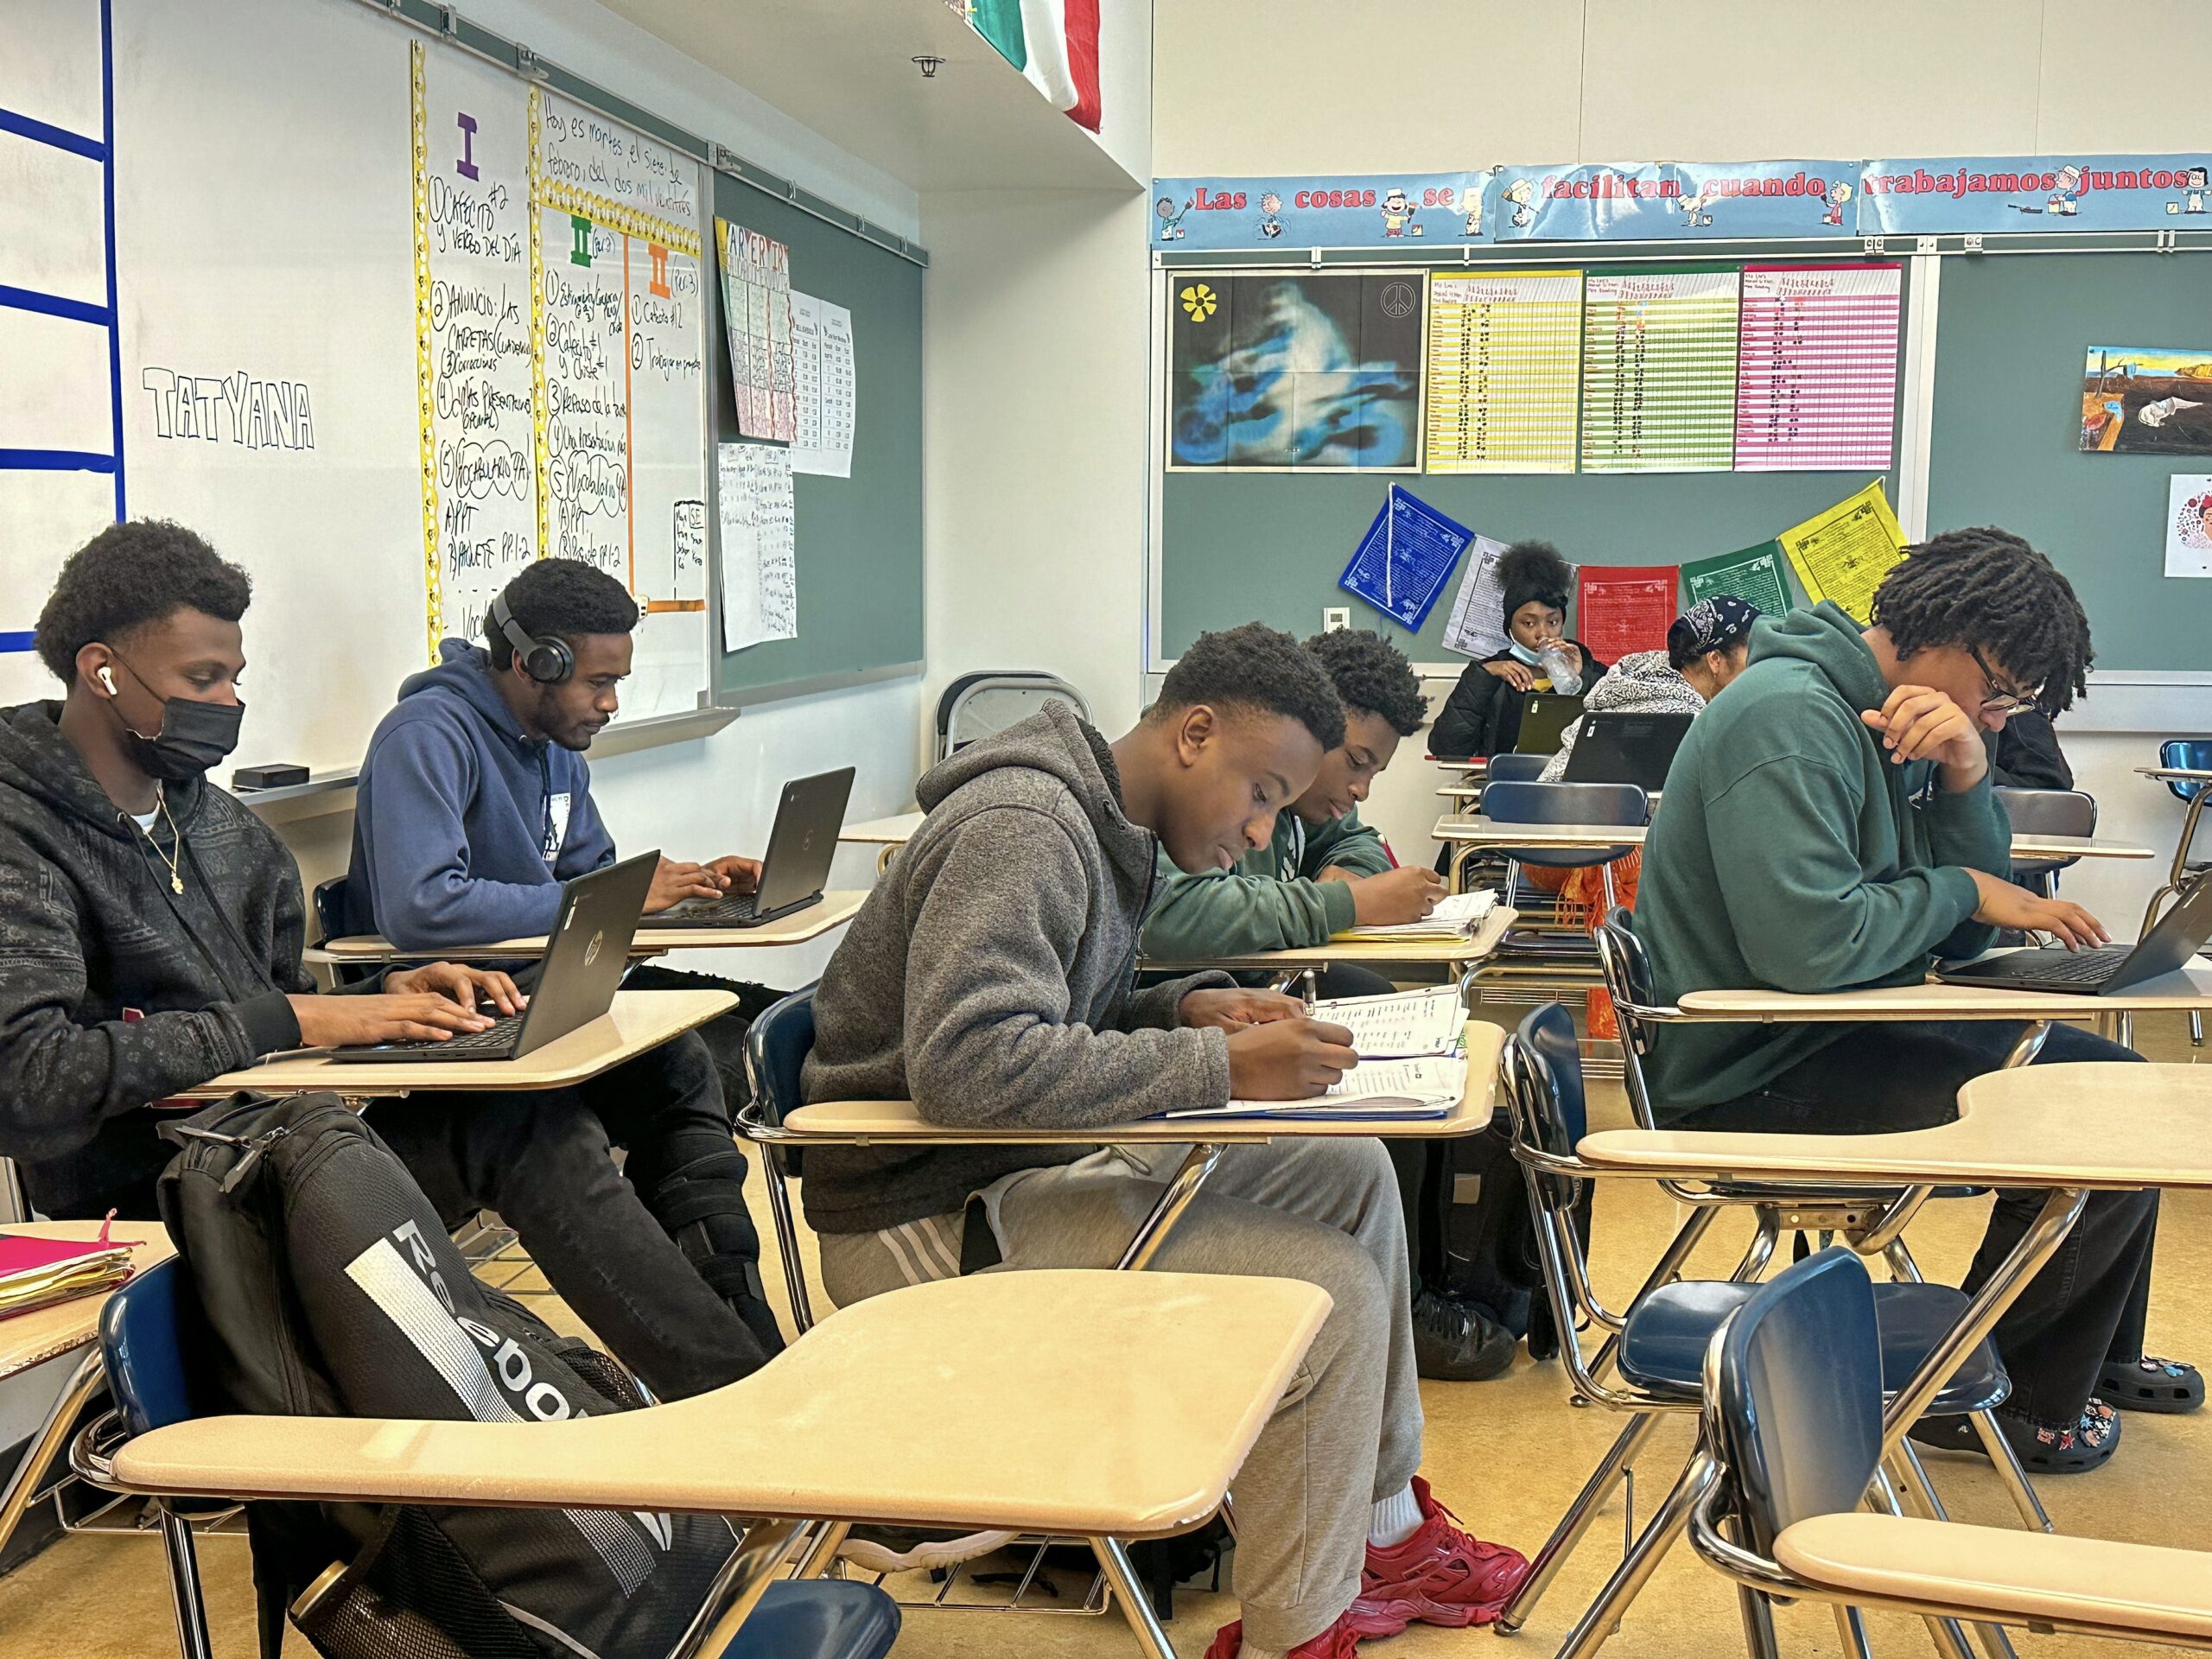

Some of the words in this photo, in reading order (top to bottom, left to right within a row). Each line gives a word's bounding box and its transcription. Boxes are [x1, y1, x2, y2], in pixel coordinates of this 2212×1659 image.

[544, 94, 566, 142] Hoy
[572, 118, 584, 138] es
[630, 136, 640, 163] el
[488, 181, 508, 210] #2
[589, 156, 610, 188] del
[614, 167, 632, 194] dos
[637, 179, 653, 204] mil
[1195, 188, 1247, 211] Las
[1294, 188, 1376, 209] cosas
[1422, 188, 1455, 207] se
[1541, 175, 1681, 200] facilitan
[1702, 172, 1827, 199] cuando
[1864, 168, 2056, 200] trabajamos
[2075, 166, 2190, 198] juntos
[453, 226, 480, 254] VERBO
[482, 234, 500, 257] DEL
[729, 225, 745, 258] AR
[751, 235, 766, 267] ER
[772, 243, 784, 274] IR
[448, 323, 495, 353] CARPETAS
[143, 367, 315, 451] TATYANA
[454, 500, 480, 537] PPT
